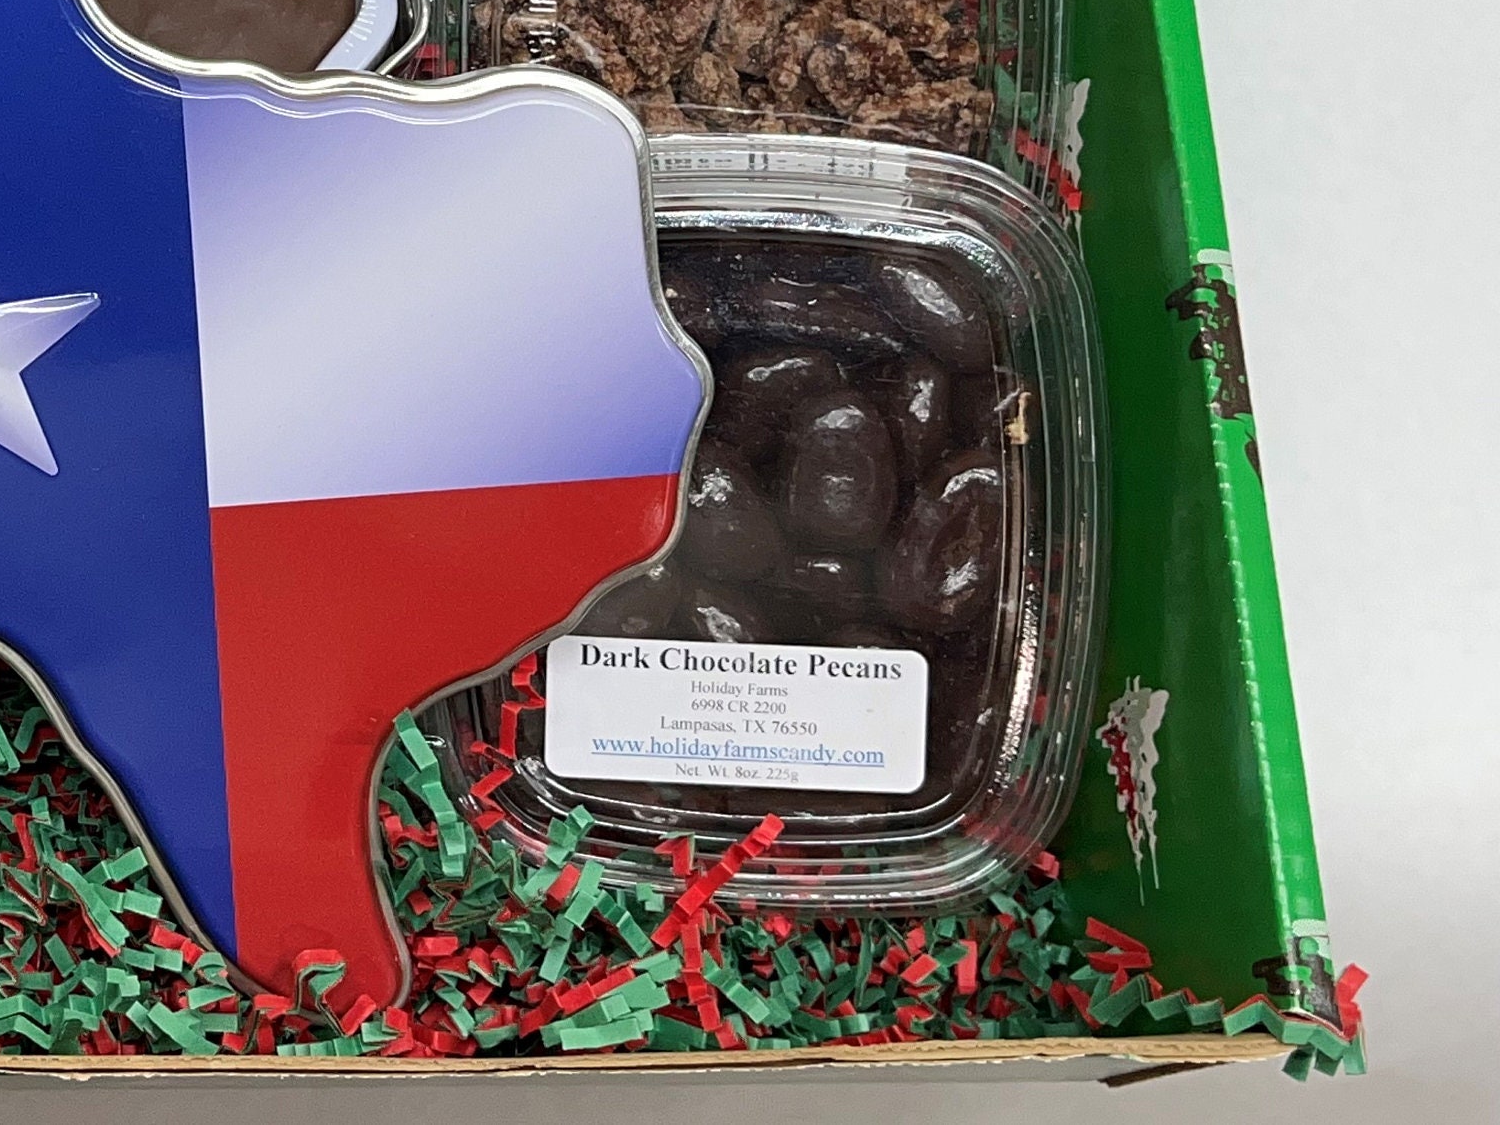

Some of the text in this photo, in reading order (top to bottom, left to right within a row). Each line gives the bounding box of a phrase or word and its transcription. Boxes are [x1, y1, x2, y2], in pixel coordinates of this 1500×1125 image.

[580, 643, 903, 680] Dark Chocolate Pecans
[691, 681, 788, 697] Holiday Farms
[690, 699, 786, 714] 6998 CR 2200
[660, 716, 818, 736] Lampasas, TX 76550
[591, 737, 885, 767] www.holidayfarmscandy.com
[765, 767, 799, 782] 225g
